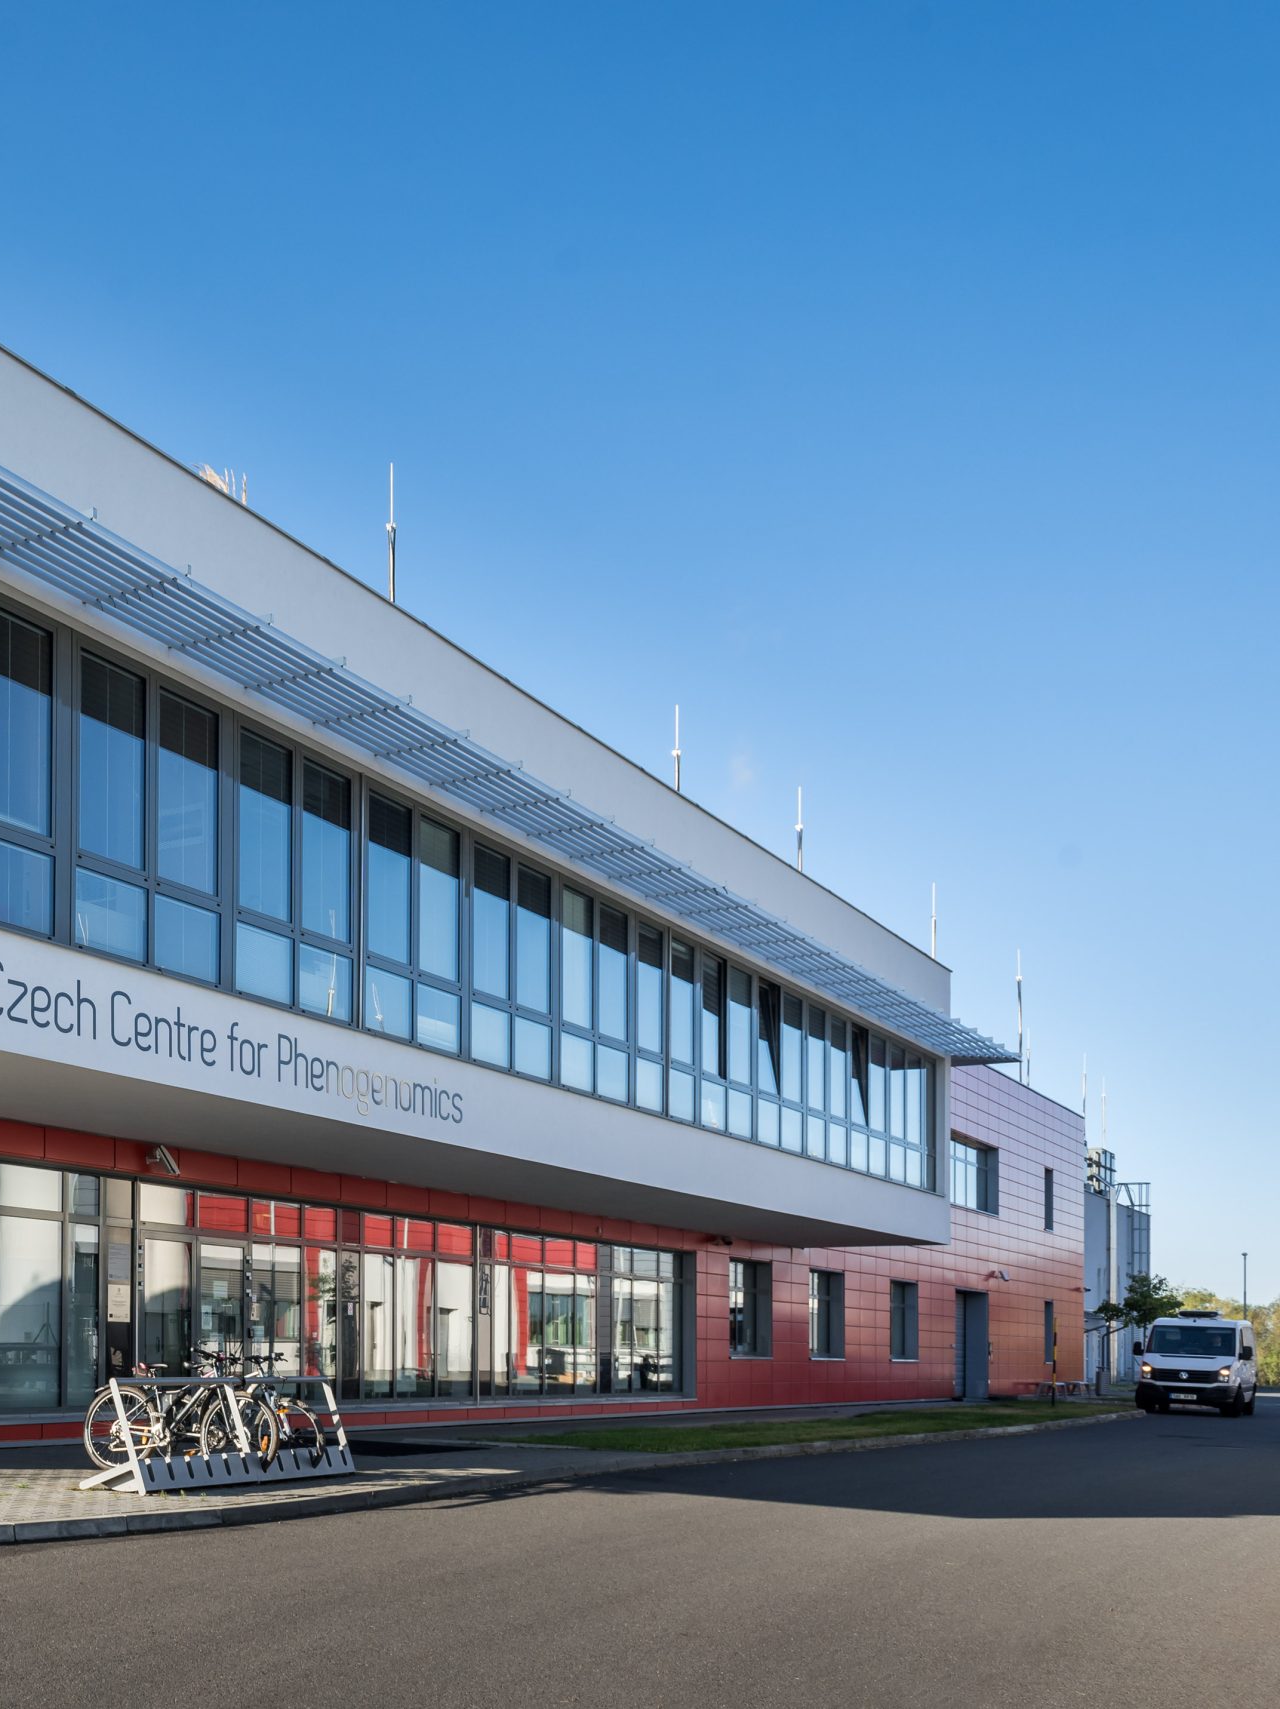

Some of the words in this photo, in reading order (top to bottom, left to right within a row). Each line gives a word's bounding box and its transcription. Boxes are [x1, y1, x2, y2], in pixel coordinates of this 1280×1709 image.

[110, 990, 217, 1067] Centre
[227, 1021, 268, 1078] for
[277, 1033, 463, 1124] Phenogenomics
